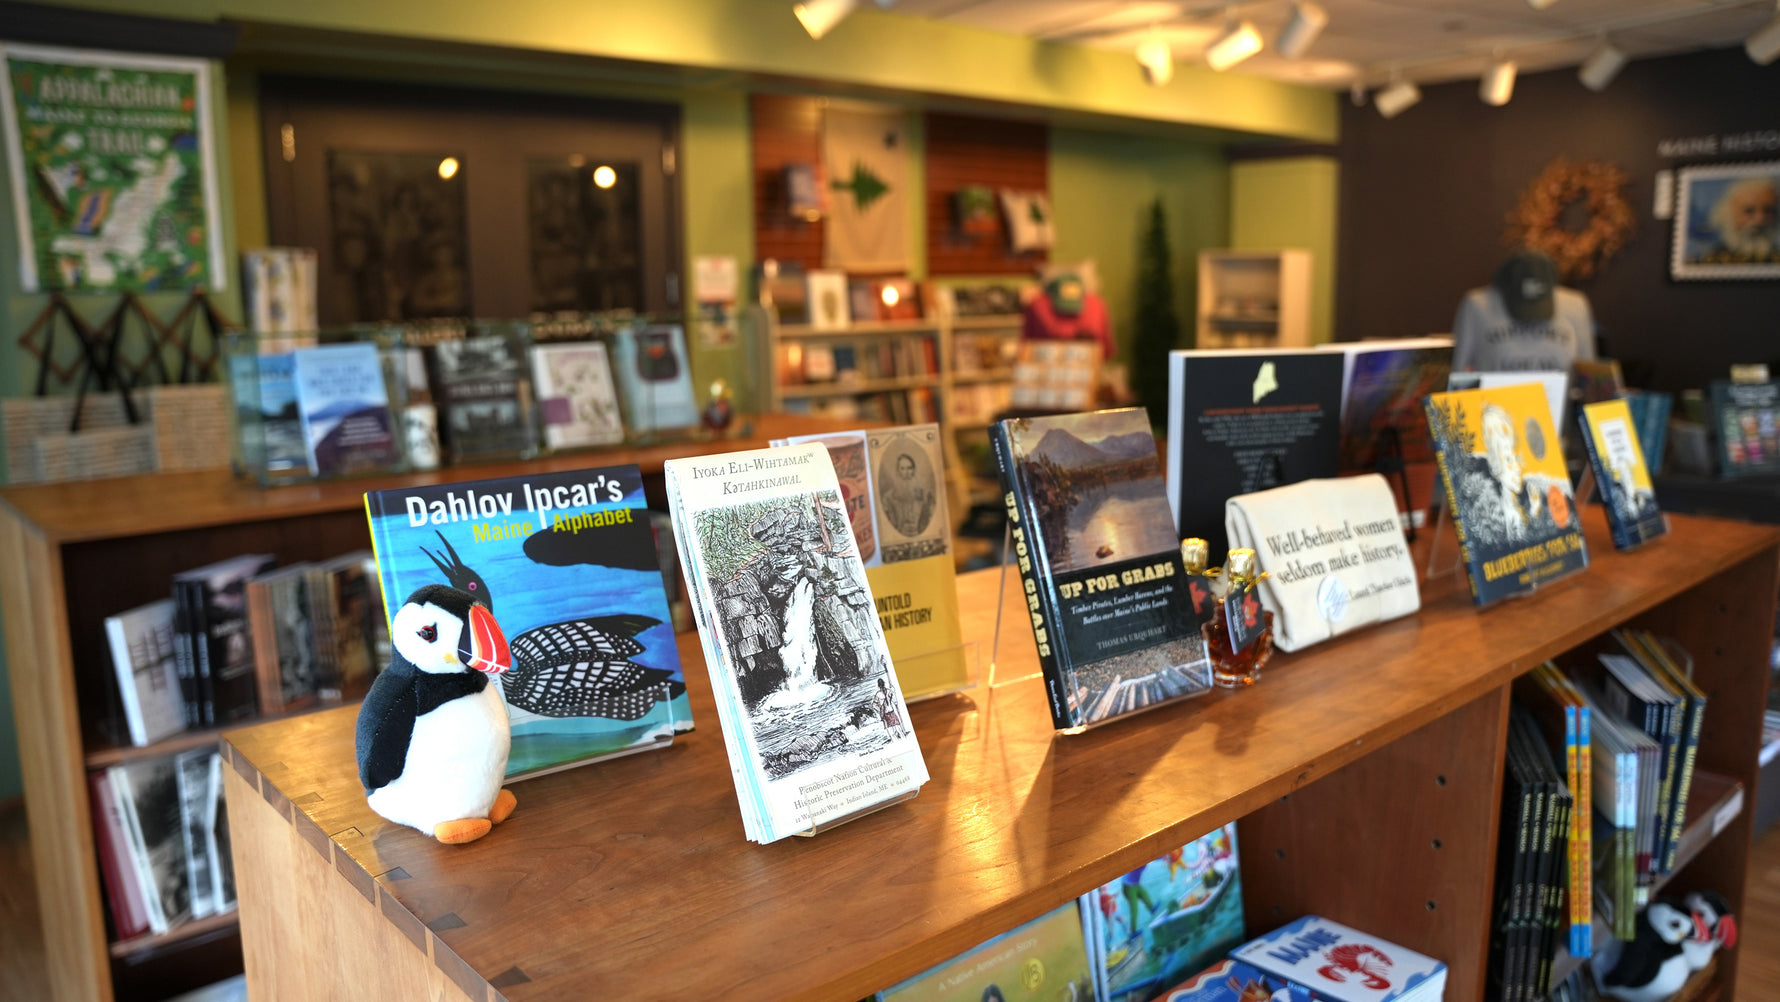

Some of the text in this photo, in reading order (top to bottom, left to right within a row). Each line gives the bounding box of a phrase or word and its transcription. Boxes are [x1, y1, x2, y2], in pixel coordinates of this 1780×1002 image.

[405, 475, 624, 529] Dahlov Ipcar's
[472, 506, 633, 543] Maine Alphabet
[1266, 518, 1395, 557] Well-behaved women
[1005, 490, 1051, 658] UP FOR GRABS
[1059, 561, 1175, 599] UP FOR GRABS
[1276, 541, 1405, 585] seldom make history.
[1482, 539, 1548, 583] BLUEBERRIES
[893, 606, 933, 629] HISTORY
[1071, 603, 1091, 615] Timber
[1113, 595, 1134, 607] Lumber
[1082, 614, 1102, 625] Battles
[1135, 602, 1152, 613] Public
[1096, 625, 1168, 650] THOMAS URQUHART
[794, 765, 904, 810] Historic Preservation Department
[798, 777, 835, 796] Penobscot
[836, 767, 858, 784] Nation
[858, 757, 886, 776] Cultural
[878, 783, 889, 793] ME
[938, 937, 1038, 992] A Native American Story
[1267, 926, 1341, 966] MAINE
